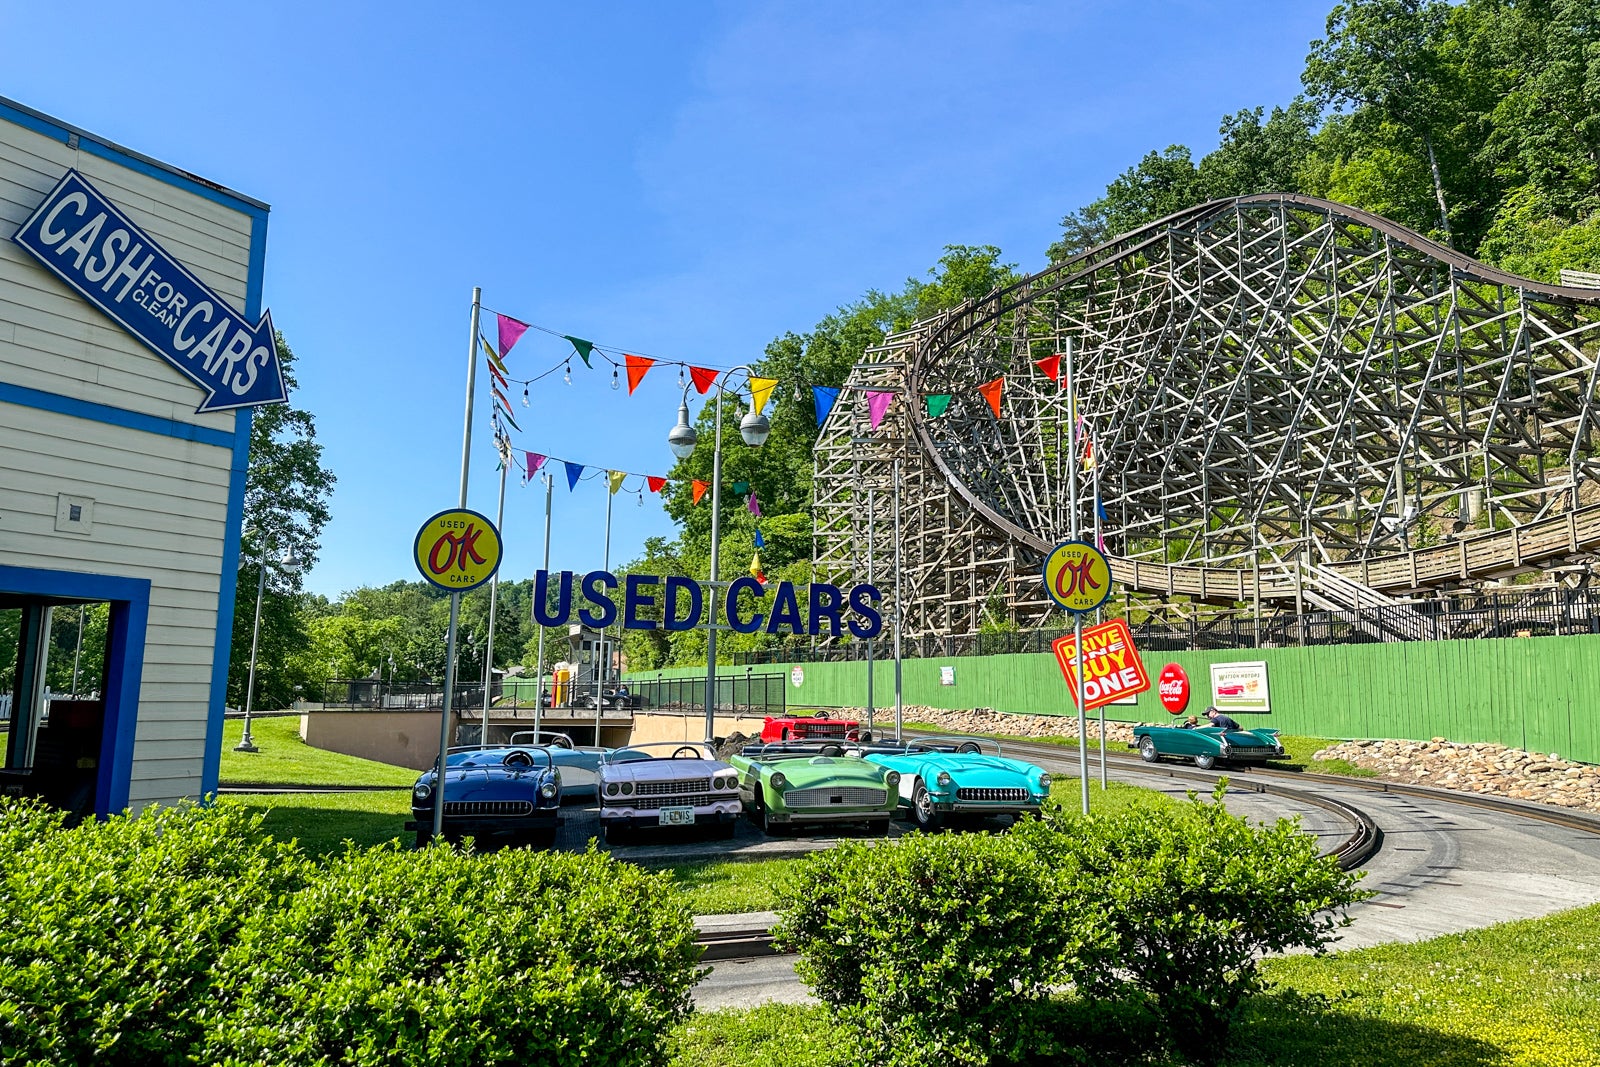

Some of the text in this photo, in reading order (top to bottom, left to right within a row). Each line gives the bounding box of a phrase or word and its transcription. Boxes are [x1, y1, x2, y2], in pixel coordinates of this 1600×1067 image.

[39, 191, 155, 303] CASH
[132, 289, 178, 329] CLEAN
[140, 270, 188, 317] FOR
[173, 300, 269, 396] CARS
[440, 520, 466, 529] USED
[428, 522, 487, 575] OK
[450, 574, 475, 583] CARS
[1055, 552, 1101, 599] OK
[531, 569, 882, 639] USED CARS
[1073, 598, 1094, 606] CARS
[1062, 628, 1122, 660] DRIVE
[1068, 641, 1126, 665] ONE
[1071, 648, 1126, 682] BUY
[1082, 666, 1140, 701] ONE
